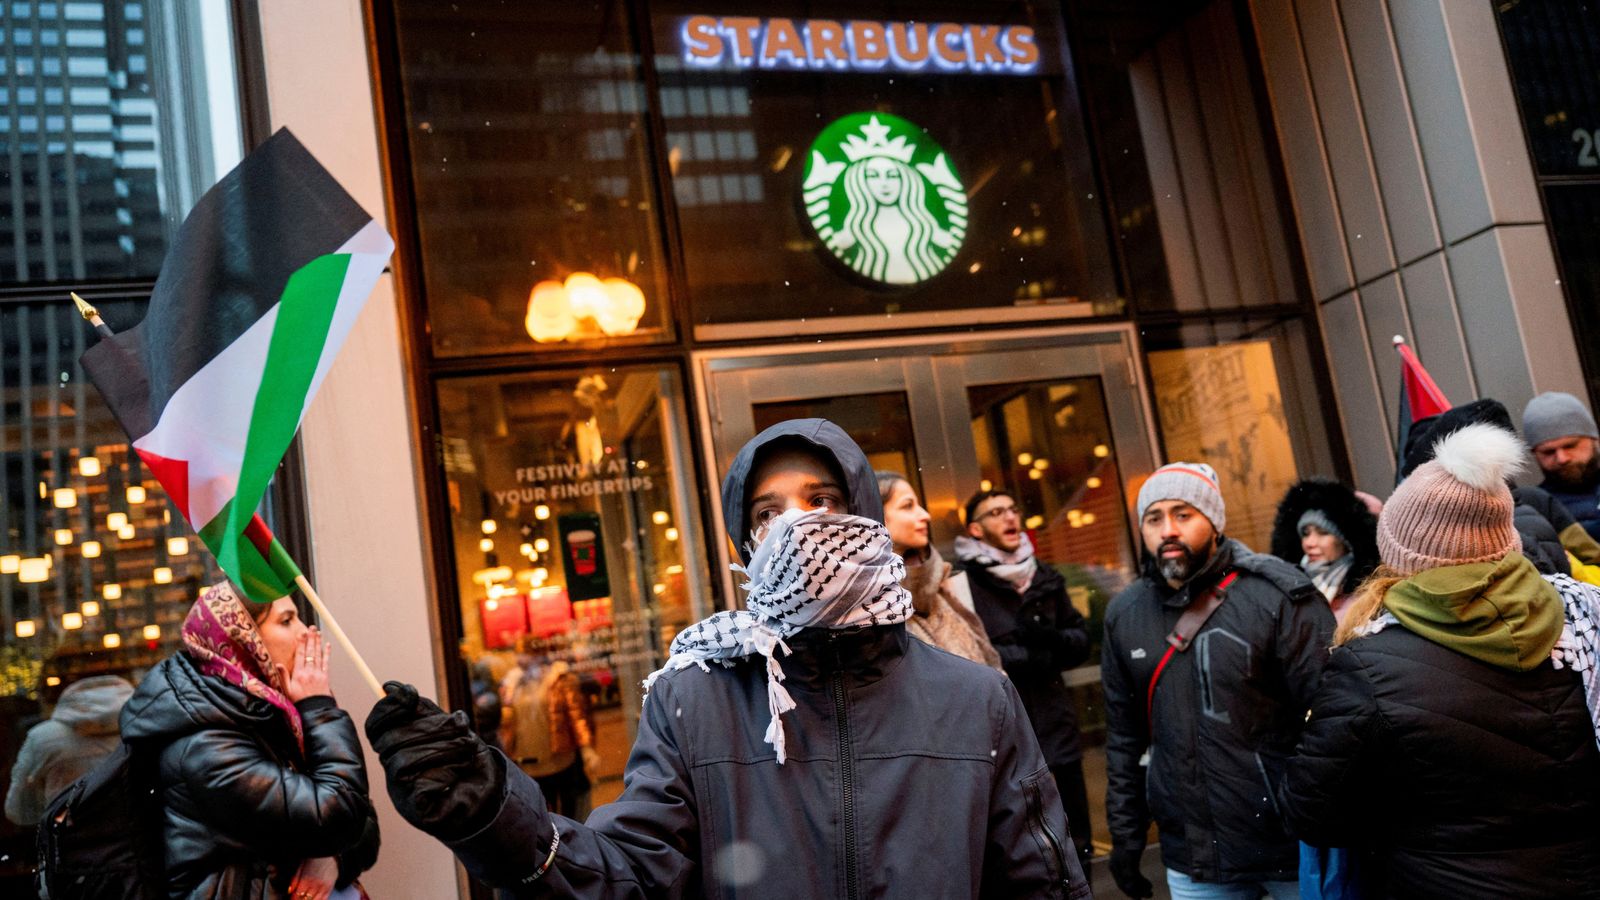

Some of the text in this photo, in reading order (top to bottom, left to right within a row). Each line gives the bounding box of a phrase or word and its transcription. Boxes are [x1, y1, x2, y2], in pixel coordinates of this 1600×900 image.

[683, 15, 1040, 71] STARBUCKS
[1572, 128, 1600, 167] 2
[516, 457, 627, 482] FESTIVITY AT
[495, 476, 653, 506] YOUR FINGERTIPS
